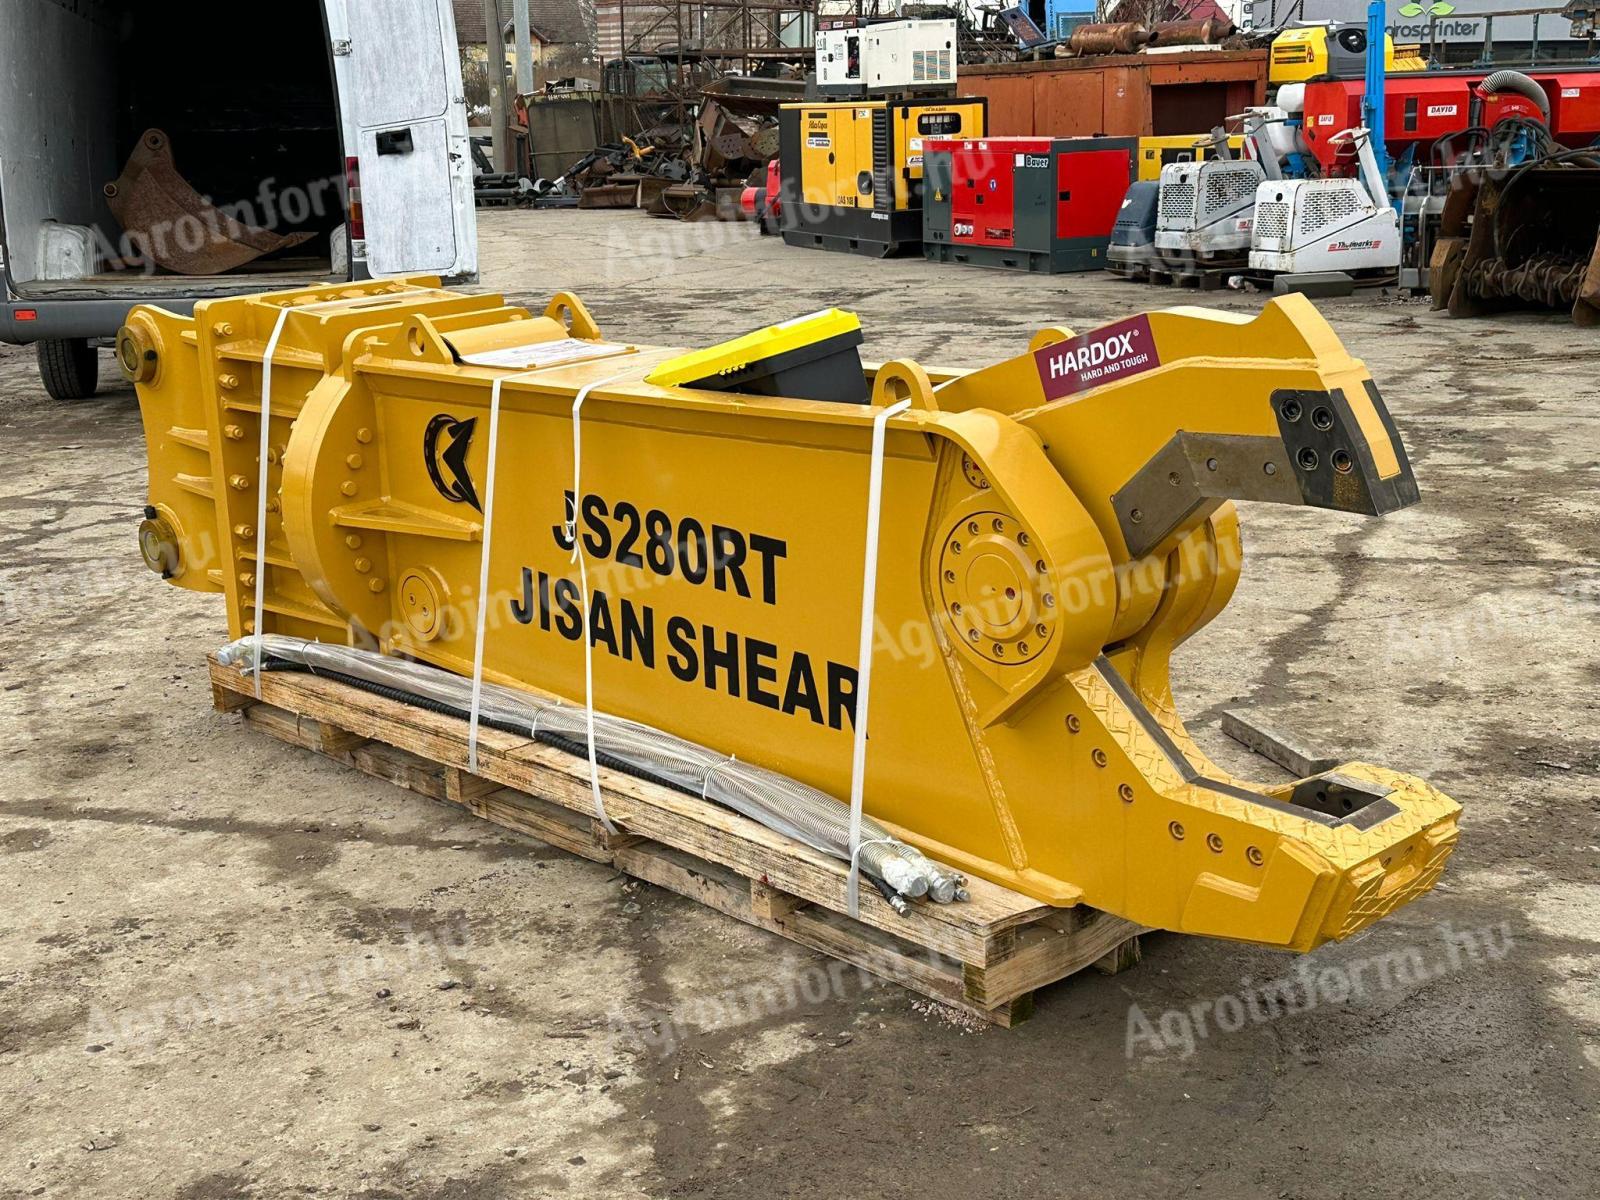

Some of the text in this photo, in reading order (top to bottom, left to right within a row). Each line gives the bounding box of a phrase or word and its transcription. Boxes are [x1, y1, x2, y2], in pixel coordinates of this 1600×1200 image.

[1080, 353, 1149, 382] HARD AND TOUGH
[552, 489, 787, 606] JS280RT
[510, 566, 870, 740] JISAN SHEAR
